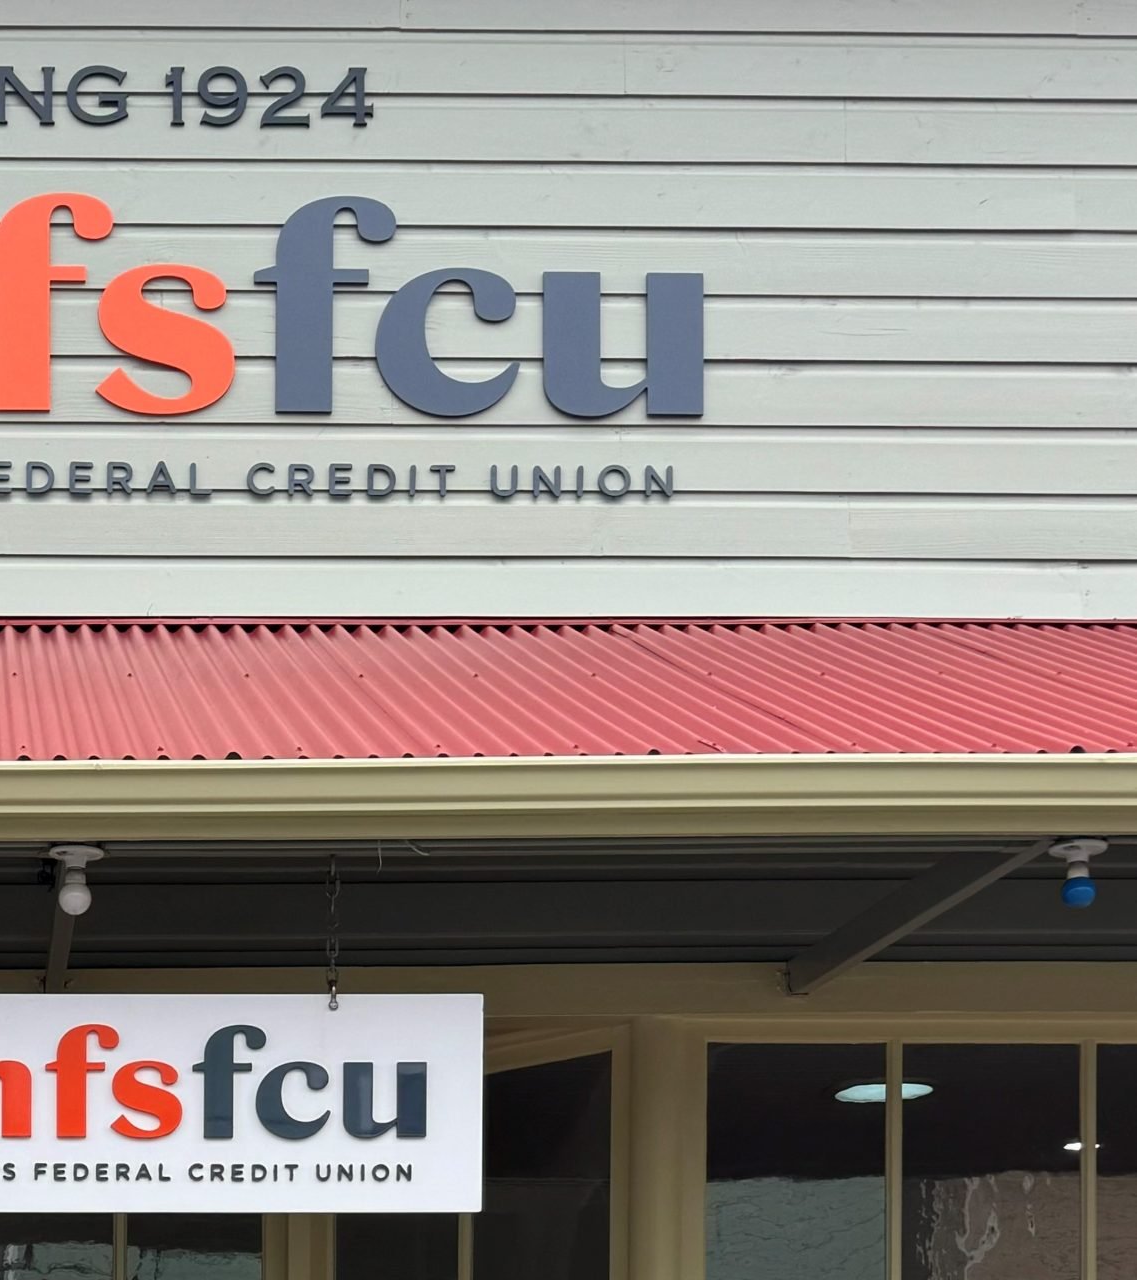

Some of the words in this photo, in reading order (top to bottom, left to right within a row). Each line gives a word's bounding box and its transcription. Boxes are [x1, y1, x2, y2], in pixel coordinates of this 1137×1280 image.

[164, 65, 375, 129] 1924
[245, 462, 457, 498] CREDIT
[489, 463, 675, 499] UNION
[33, 1162, 172, 1183] FEDERAL
[187, 1163, 299, 1183] CREDIT
[315, 1163, 414, 1183] UNION
